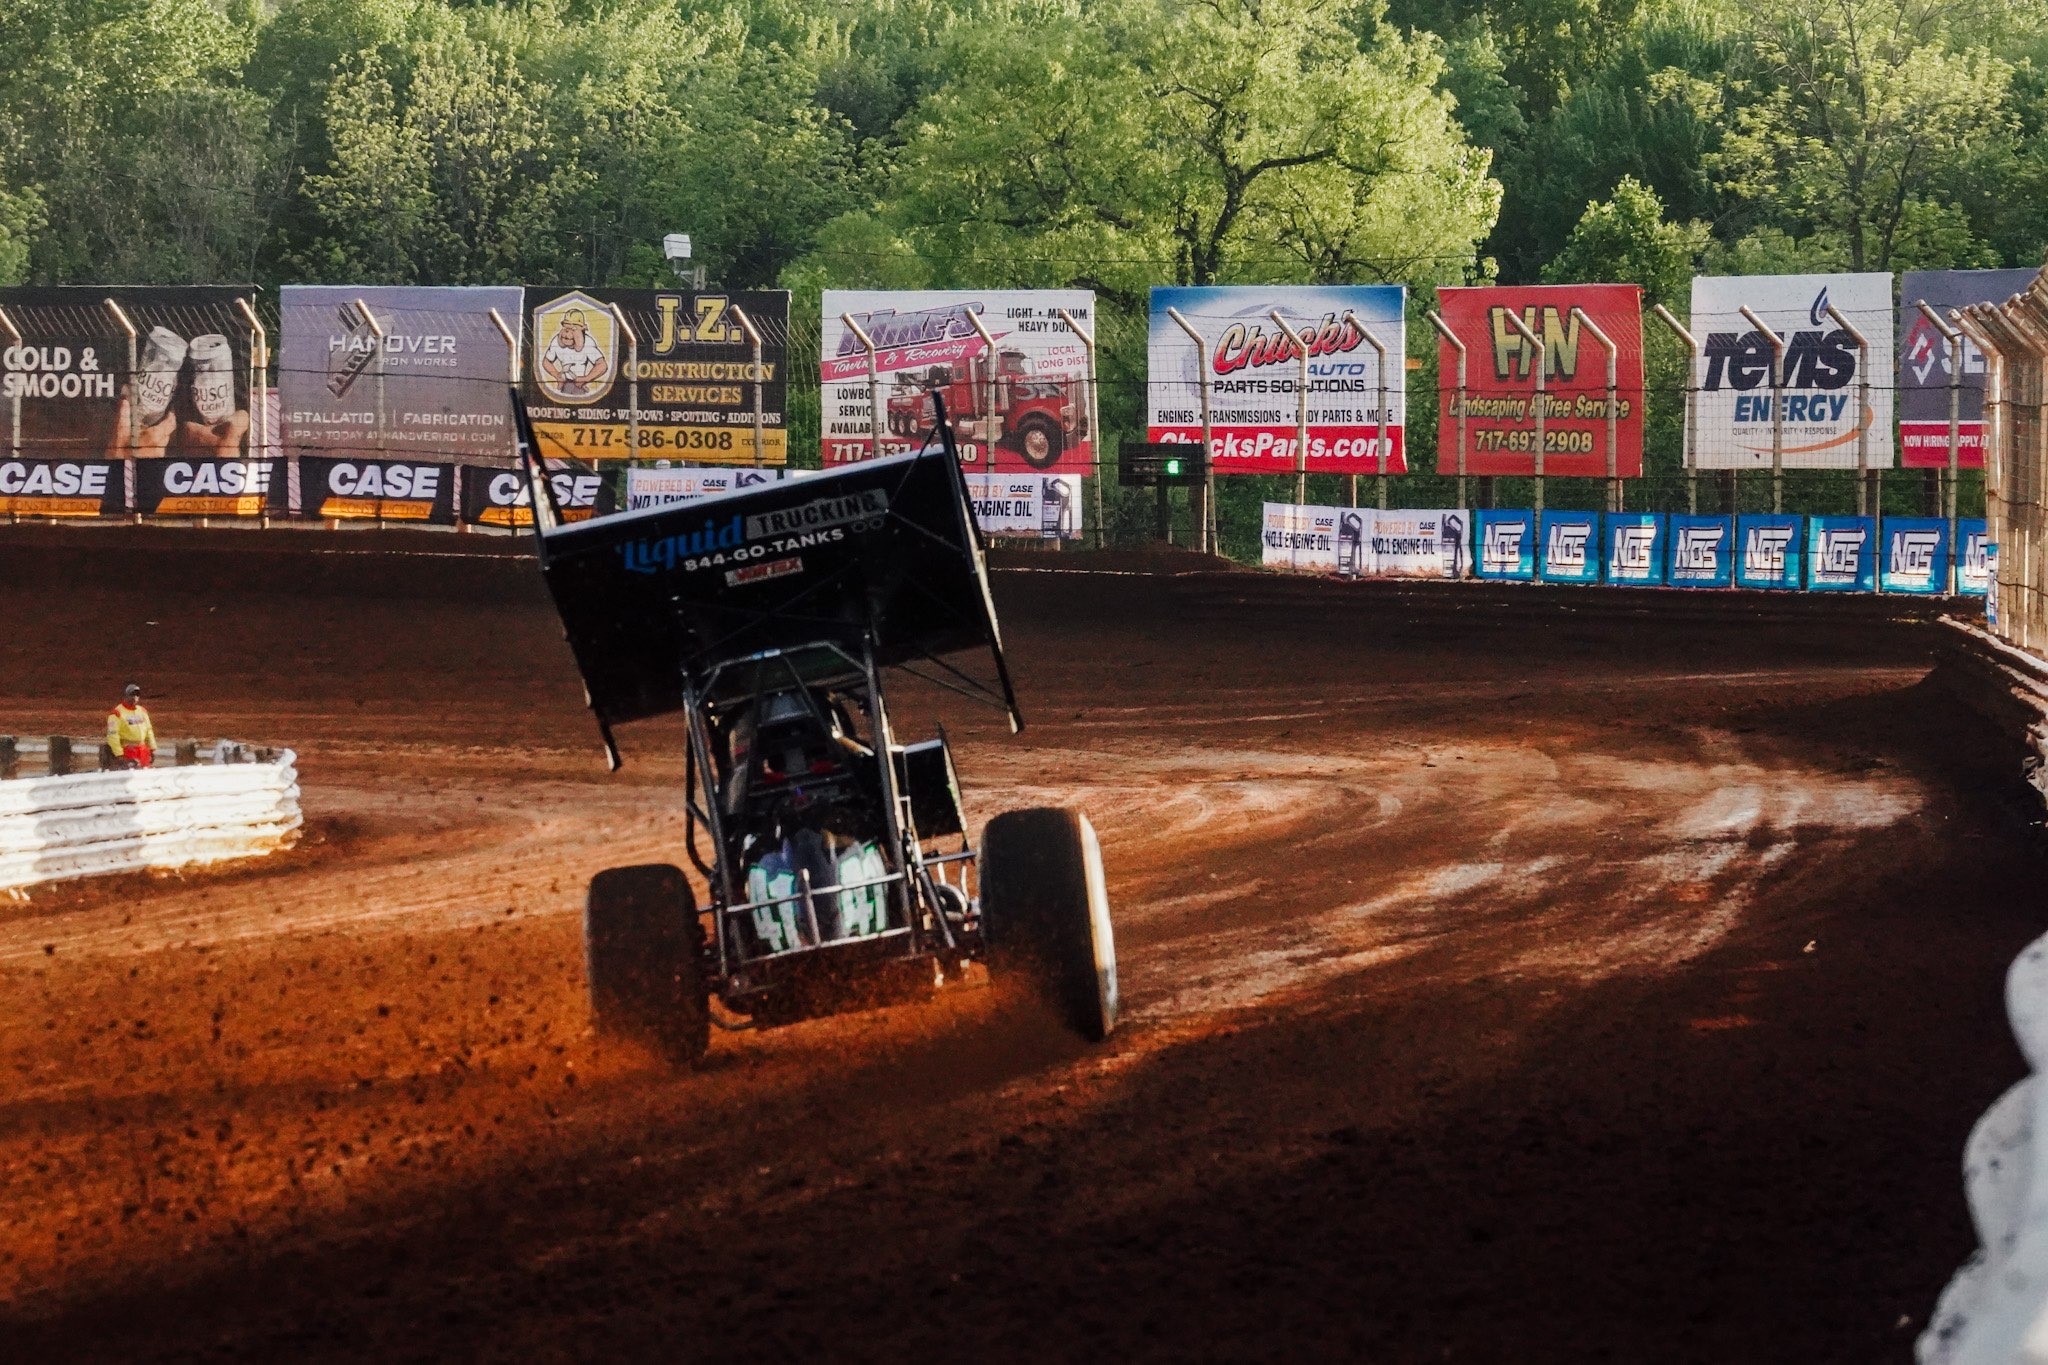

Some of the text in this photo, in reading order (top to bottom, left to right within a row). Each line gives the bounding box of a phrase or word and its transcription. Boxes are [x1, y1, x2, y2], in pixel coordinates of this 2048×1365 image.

[1007, 308, 1087, 319] LIGHT MEIUM
[1018, 321, 1076, 332] HEAVY DUT
[329, 334, 457, 353] HANOVER
[1048, 345, 1075, 355] LOCAL
[1213, 310, 1365, 375] Chuck's
[3, 346, 99, 371] COLD &
[381, 357, 458, 367] RON WORKS
[831, 344, 967, 373] Towin & Recovery
[1038, 358, 1063, 369] LONG
[623, 362, 775, 380] CONSTRUCTION
[1307, 364, 1365, 376] AUTO
[2, 372, 115, 398] SMOOTH
[837, 388, 872, 400] LOWBO
[1214, 380, 1267, 393] PARTS
[652, 386, 742, 404] SERVICES
[527, 407, 781, 424] ROOFING SIDING WIDOWS SPOUTING ADDITONS
[839, 405, 872, 416] SERVIC
[1158, 410, 1393, 422] ENGINES TRANSMISSIONS DY PARTS & MOE
[1449, 393, 1526, 423] Lndscaping
[1543, 394, 1572, 418] Tree
[1575, 394, 1630, 419] Servce
[1734, 394, 1848, 422] ENERGY
[281, 412, 504, 425] INSTALLATIO FABRICATION
[830, 422, 884, 434] AVAILAB!
[1732, 427, 1837, 435] QUALITY INTRITY RESPONSE
[573, 428, 732, 450] 717-586-0308
[741, 438, 780, 446] EXTRIOR
[1160, 432, 1393, 458] cksParts.com
[1475, 430, 1594, 453] 717-6972908
[1904, 435, 1922, 447] NOW
[1923, 435, 1950, 447] HIRING
[0, 462, 109, 495] CASE
[163, 462, 274, 494] CASE
[328, 462, 440, 497] CASE
[636, 480, 682, 492] POWERED
[685, 480, 698, 492] BY
[702, 479, 727, 487] CASE
[992, 485, 1005, 497] BY
[632, 495, 660, 510] NO1
[972, 500, 1032, 517] ENGINE OIL
[1315, 518, 1334, 526] CASE
[1419, 522, 1436, 530] CASE
[615, 514, 744, 575] Liquid
[756, 492, 882, 536] TRUCKING
[1265, 531, 1331, 551] NO.1 ENGINE OIL
[1482, 518, 1526, 564] NOS
[1546, 519, 1591, 566] NOS
[683, 528, 844, 572] 844-GO-TANKS
[1371, 537, 1435, 555] NO.1 ENGINE OIL
[1611, 520, 1657, 569] NOS
[1674, 522, 1724, 570] NOS
[1745, 522, 1793, 570] NOS
[1815, 525, 1867, 573] NOS
[1890, 527, 1941, 575] NOS
